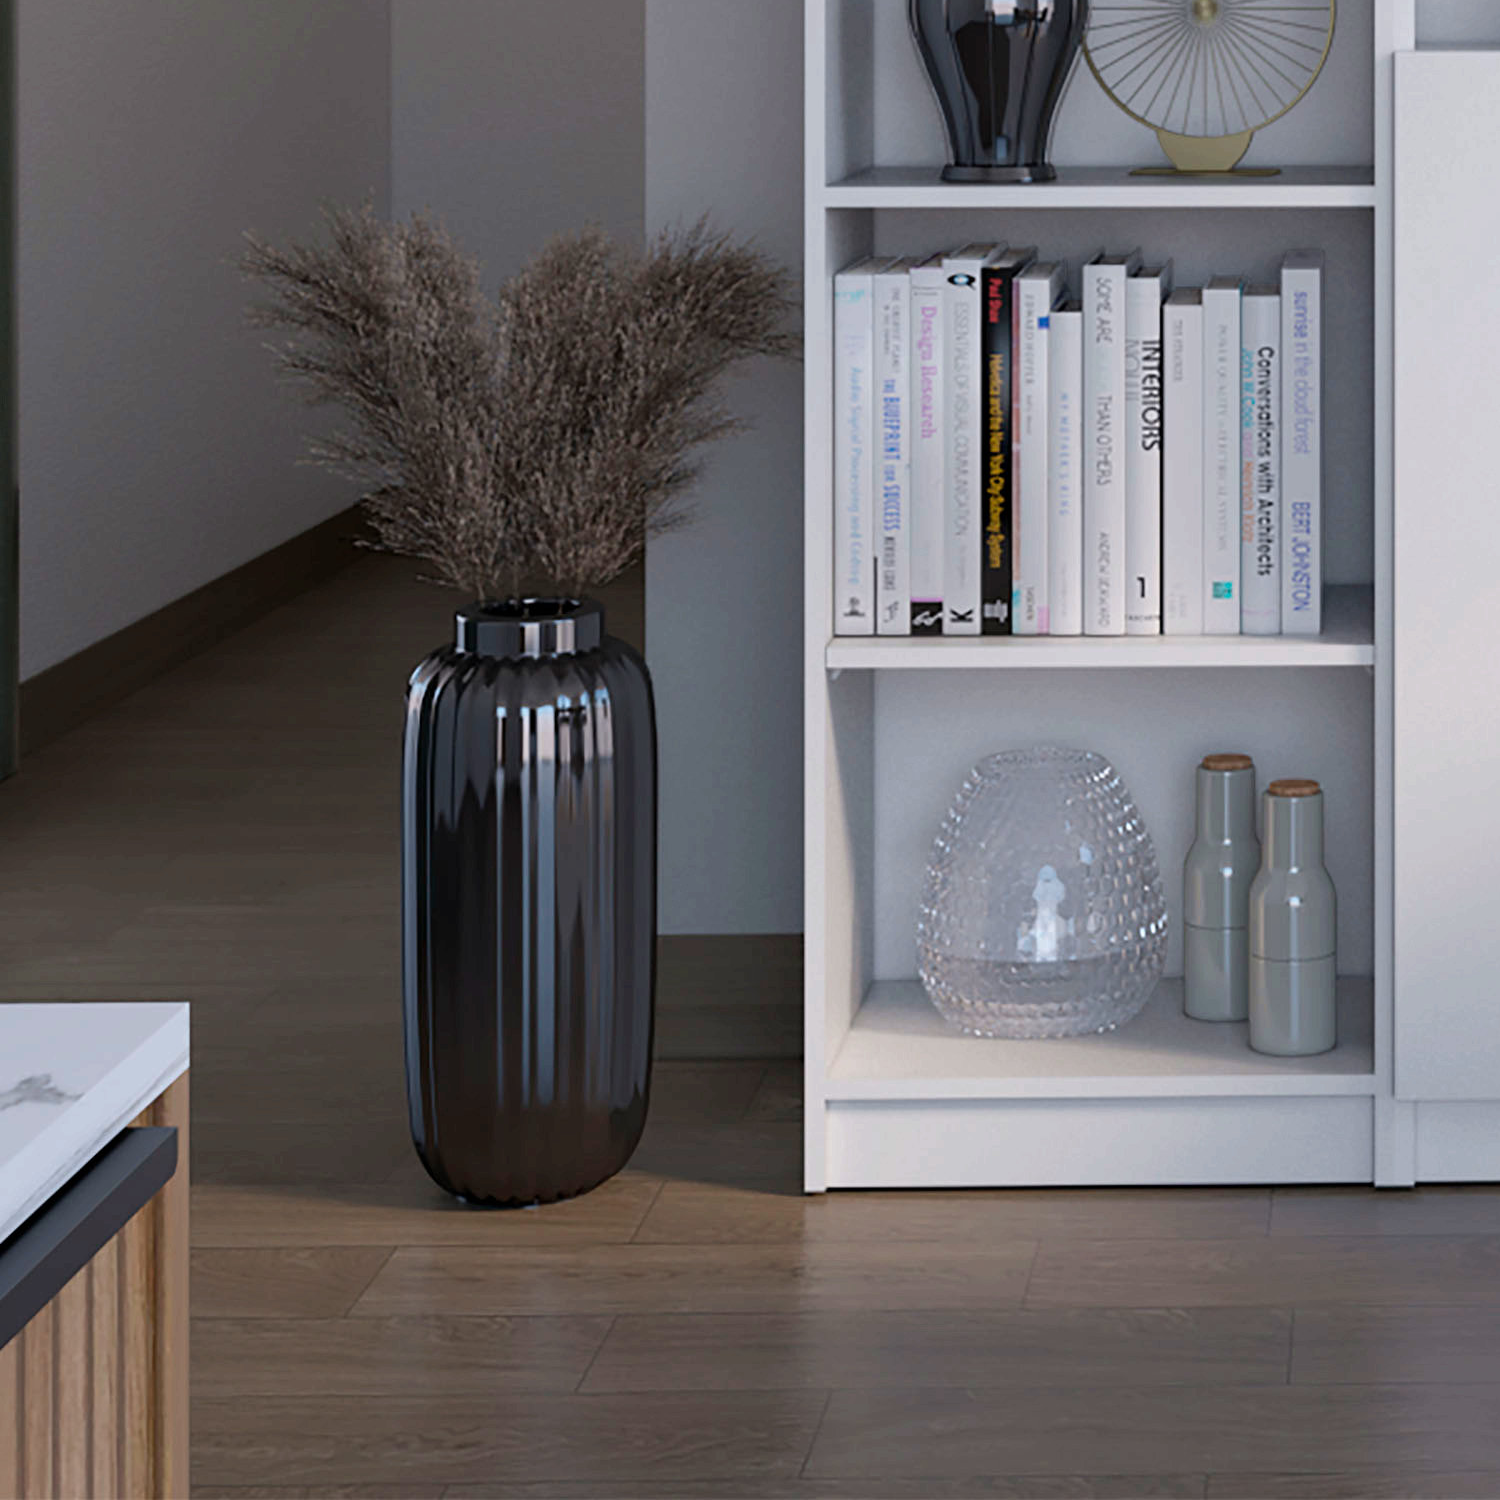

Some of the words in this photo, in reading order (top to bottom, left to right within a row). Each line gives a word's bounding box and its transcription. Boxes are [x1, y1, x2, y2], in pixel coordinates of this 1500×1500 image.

[988, 278, 1002, 297] Paul
[1096, 277, 1111, 314] SOME
[988, 299, 1002, 323] Shaw
[1294, 291, 1311, 339] sunrise
[917, 306, 937, 361] Design
[954, 301, 970, 372] ESSENTIALS
[1096, 317, 1111, 343] ARE
[1294, 342, 1311, 353] in
[989, 354, 1003, 396] Helvetica
[1294, 356, 1311, 376] the
[954, 375, 970, 393] OF
[1141, 340, 1160, 451] INTERIORS
[1257, 347, 1275, 456] Conversations
[1294, 380, 1311, 415] cloud
[921, 366, 937, 439] Research
[954, 395, 970, 436] VISUAL
[990, 398, 1003, 414] and
[1096, 395, 1111, 431] THAN
[883, 397, 900, 461] BLUEPRINT
[990, 416, 1003, 431] the
[1294, 419, 1311, 454] forest
[990, 432, 1003, 453] New
[990, 455, 1003, 474] York
[1096, 435, 1111, 486] OTHERS
[1257, 461, 1275, 493] with
[954, 438, 970, 536] COMMUNICATION
[986, 477, 1003, 495] City
[883, 484, 900, 531] SUCCESS
[986, 497, 1003, 532] Subway
[1292, 501, 1310, 535] BERT
[986, 535, 1003, 568] System
[1257, 499, 1275, 576] Architects
[1292, 538, 1310, 611] JOHNSTON
